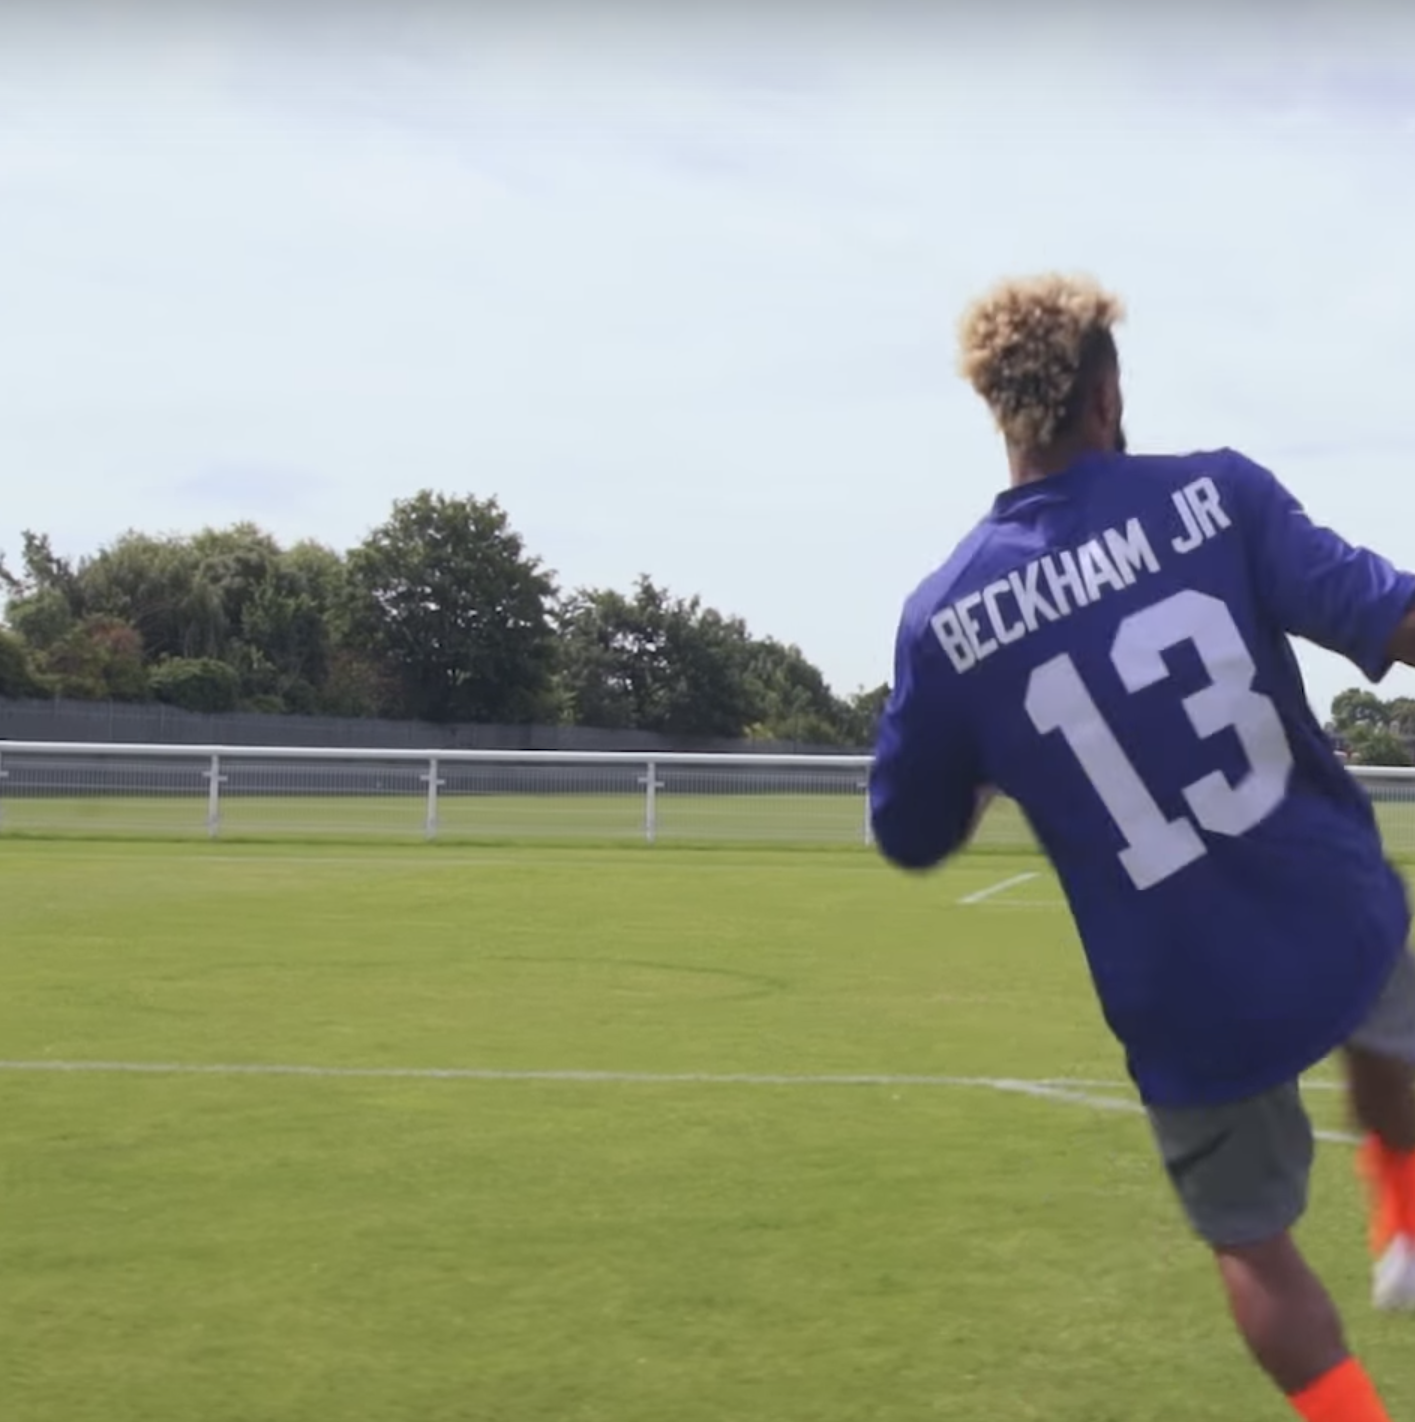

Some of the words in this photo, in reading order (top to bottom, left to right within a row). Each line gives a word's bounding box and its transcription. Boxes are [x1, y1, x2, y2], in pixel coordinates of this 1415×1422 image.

[931, 517, 1161, 674] BECKHAM
[1170, 476, 1231, 554] JR
[1024, 589, 1294, 890] 13
